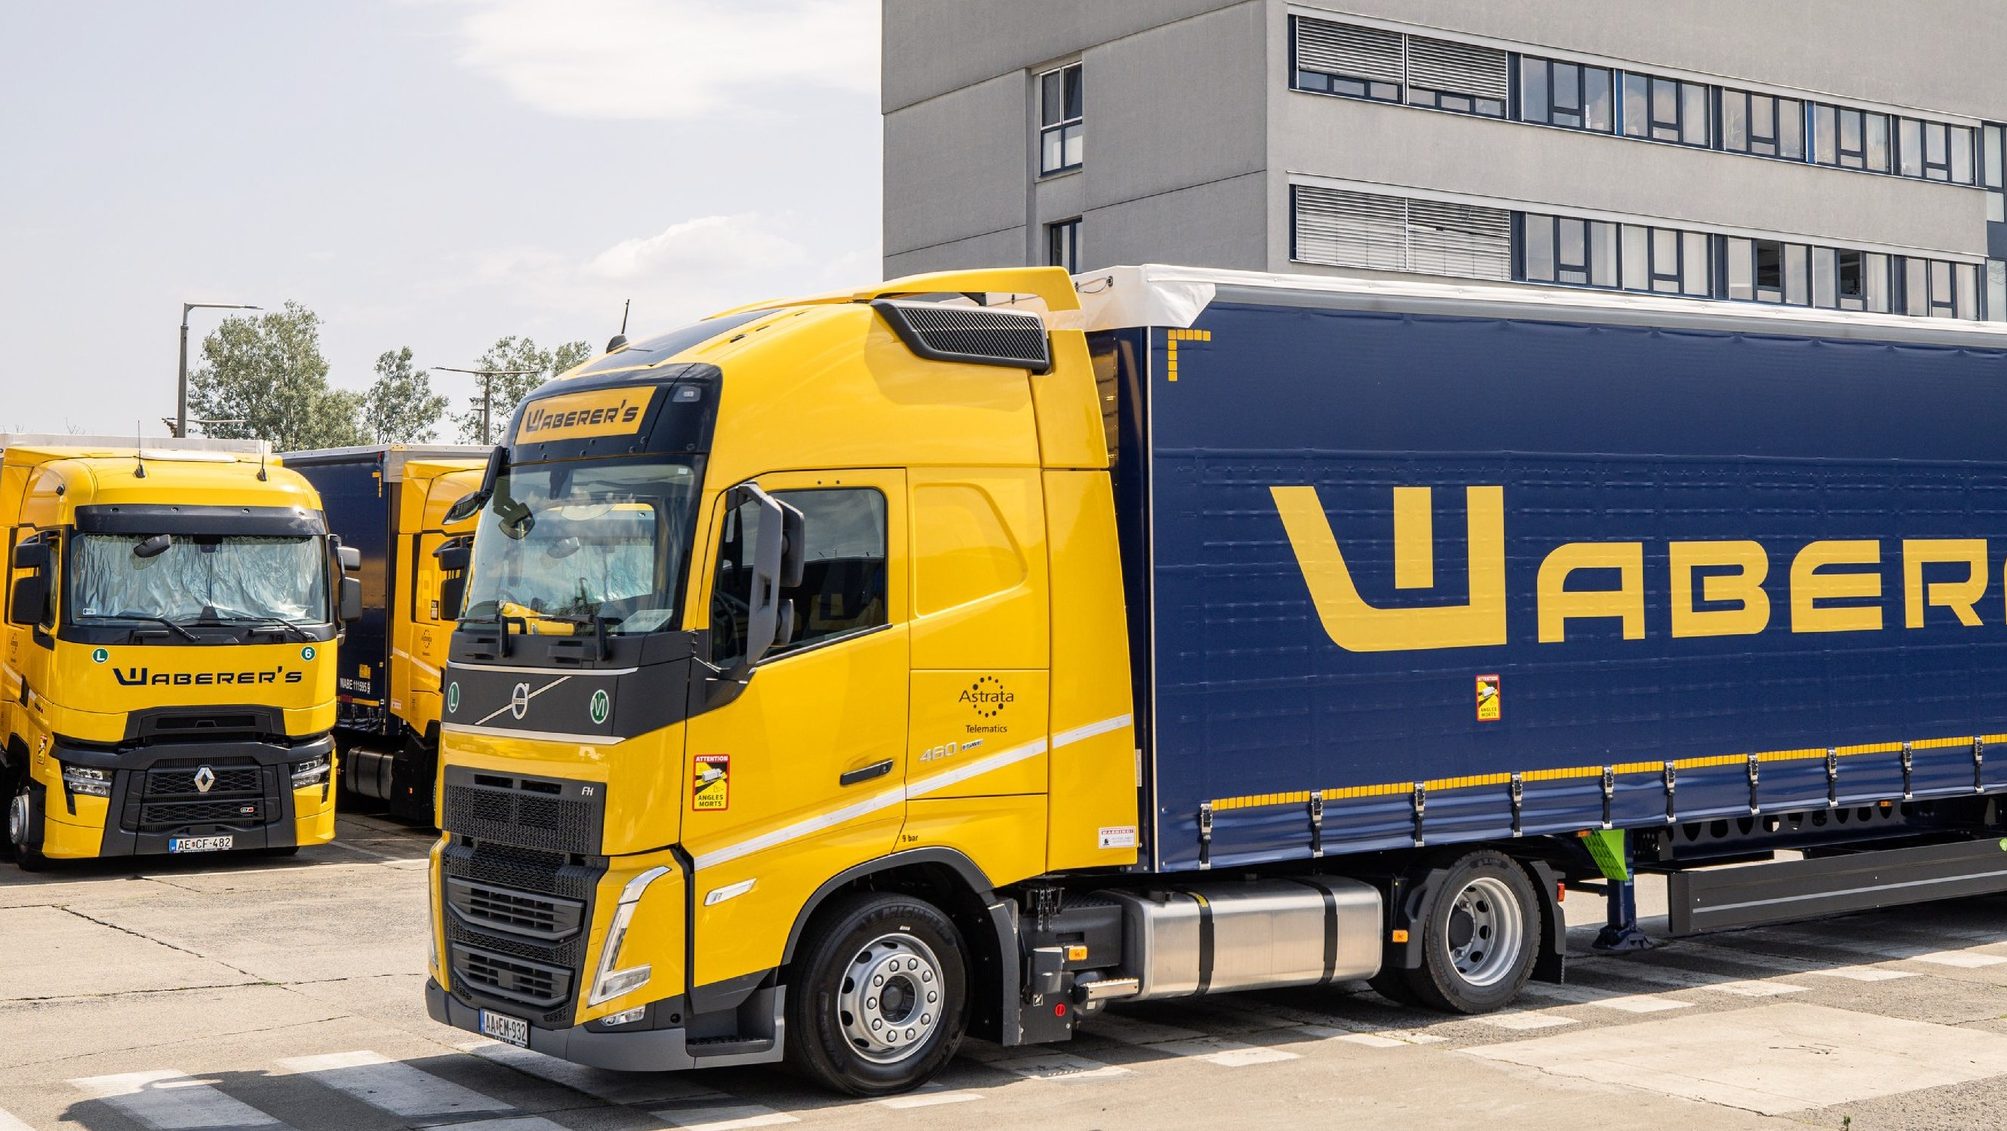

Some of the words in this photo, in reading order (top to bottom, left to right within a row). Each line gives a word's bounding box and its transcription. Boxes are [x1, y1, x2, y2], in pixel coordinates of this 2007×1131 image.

[525, 399, 640, 433] WABERER'S
[1268, 485, 2007, 653] WABER
[97, 651, 105, 660] L
[112, 665, 302, 686] WABERER'S
[958, 689, 1014, 703] Astrata
[966, 724, 1008, 734] Telematics
[920, 741, 958, 761] 460
[695, 755, 729, 763] ATTENTION
[581, 786, 595, 796] FH
[908, 834, 919, 842] bar
